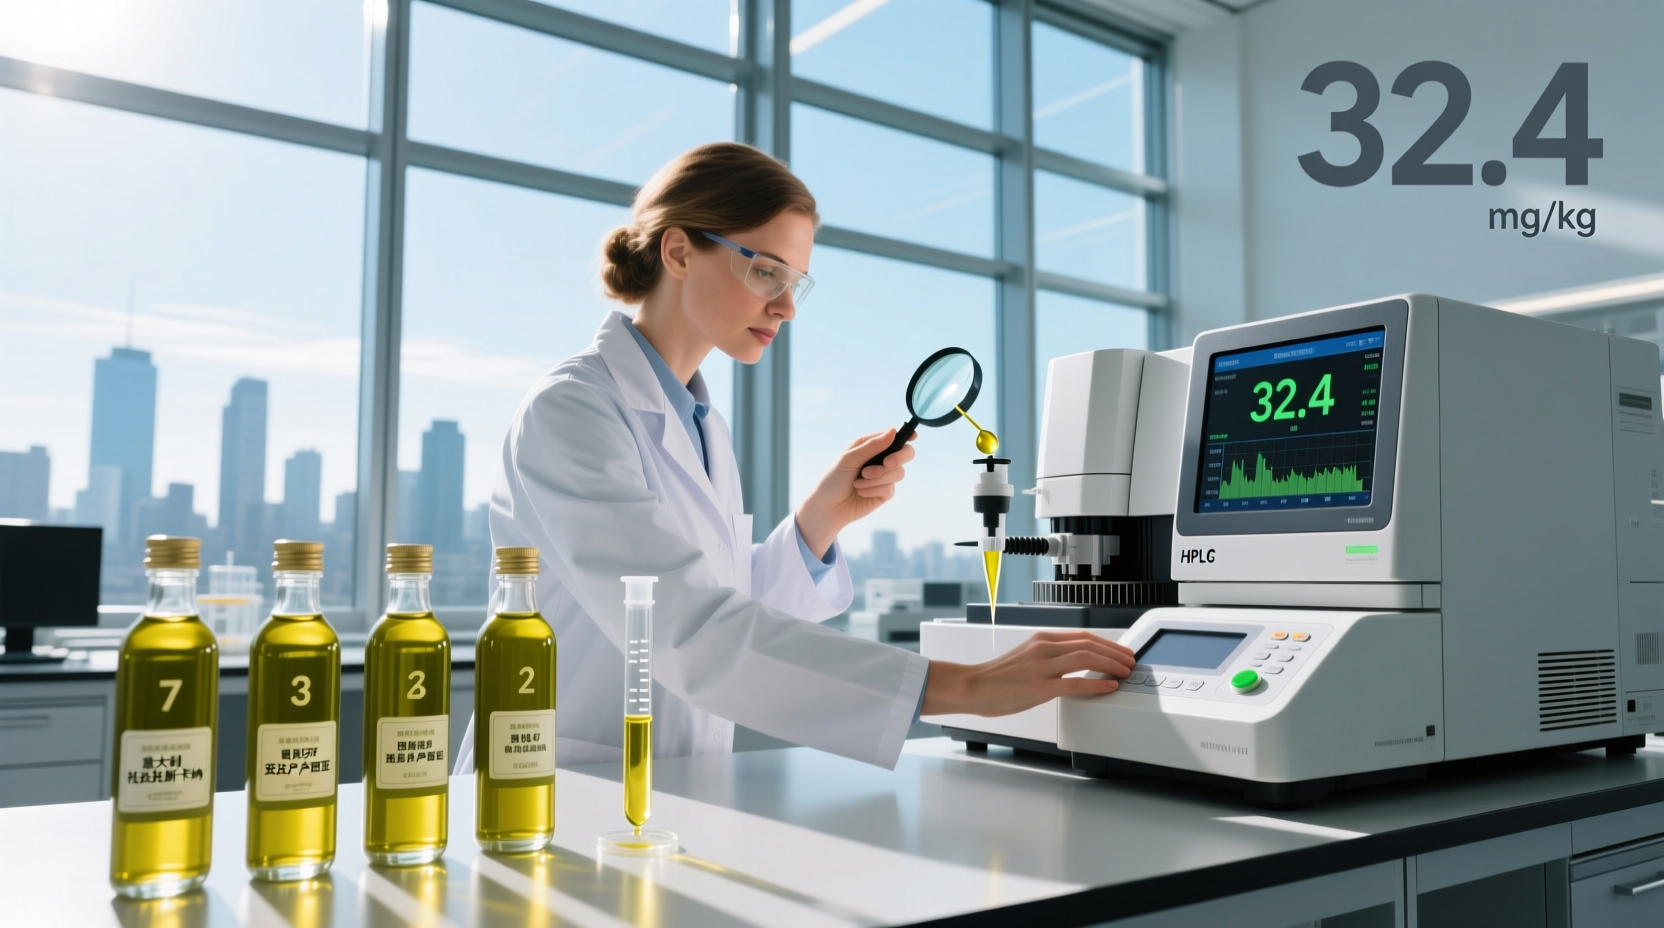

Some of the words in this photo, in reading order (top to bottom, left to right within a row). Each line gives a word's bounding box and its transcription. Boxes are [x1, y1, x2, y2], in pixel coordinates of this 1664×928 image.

[1250, 373, 1335, 423] 32.4
[159, 679, 183, 713] 7
[290, 674, 312, 707] 3
[518, 666, 536, 694] 2
